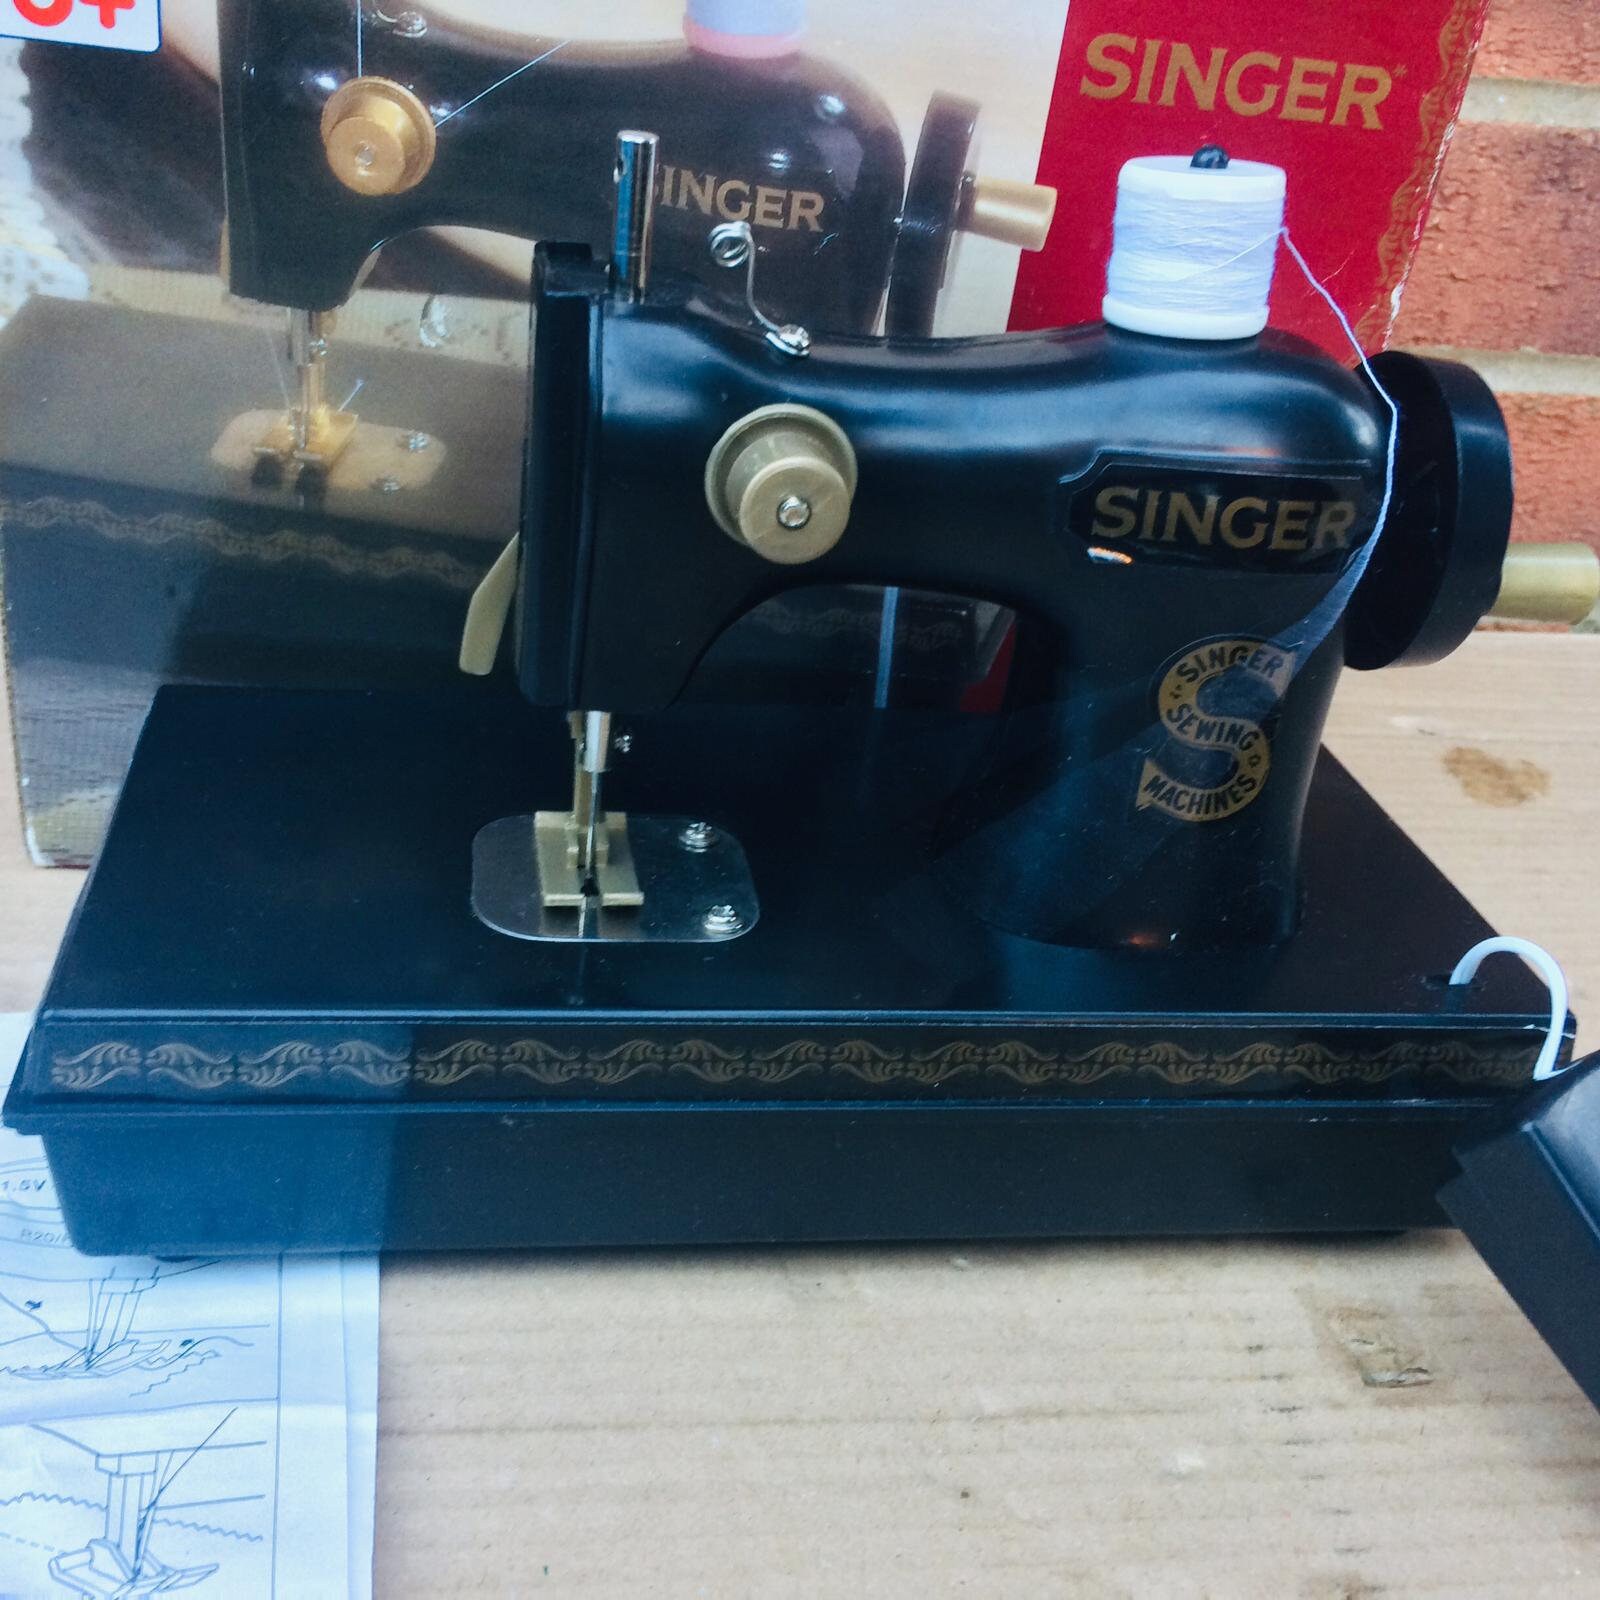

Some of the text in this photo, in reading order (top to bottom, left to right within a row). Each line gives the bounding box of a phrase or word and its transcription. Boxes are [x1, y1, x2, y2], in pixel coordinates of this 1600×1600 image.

[1079, 32, 1392, 131] SINGER
[654, 163, 825, 233] INGER
[1091, 486, 1356, 549] SINGER
[1176, 645, 1284, 683] SINGER
[1167, 703, 1259, 751] SEWING
[1143, 774, 1257, 815] MACHINES
